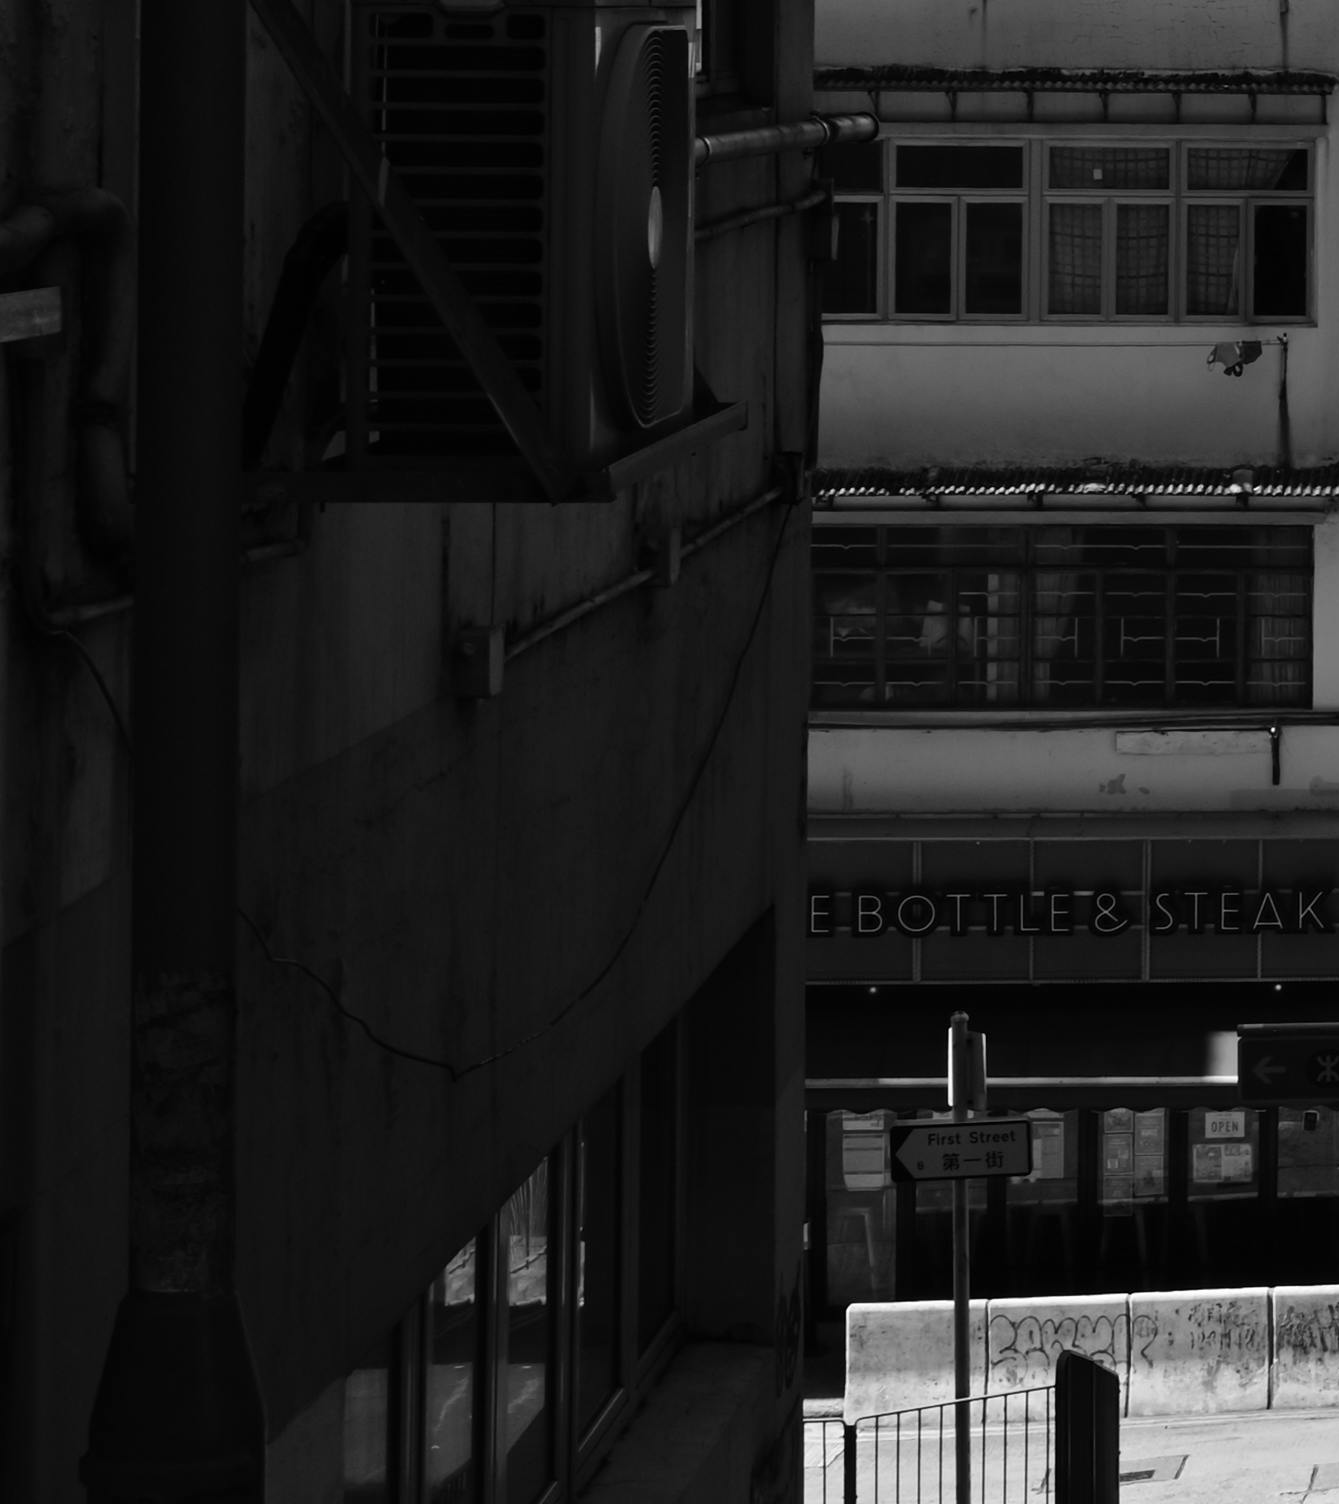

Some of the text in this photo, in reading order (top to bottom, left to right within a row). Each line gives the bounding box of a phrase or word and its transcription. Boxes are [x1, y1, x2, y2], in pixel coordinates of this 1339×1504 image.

[856, 893, 1071, 934] BOTTLE
[1094, 892, 1129, 934] &
[1152, 891, 1329, 932] STEAK
[1211, 1121, 1239, 1132] OPEN
[927, 1130, 1016, 1147] First Street
[942, 1151, 1005, 1171] 第一街
